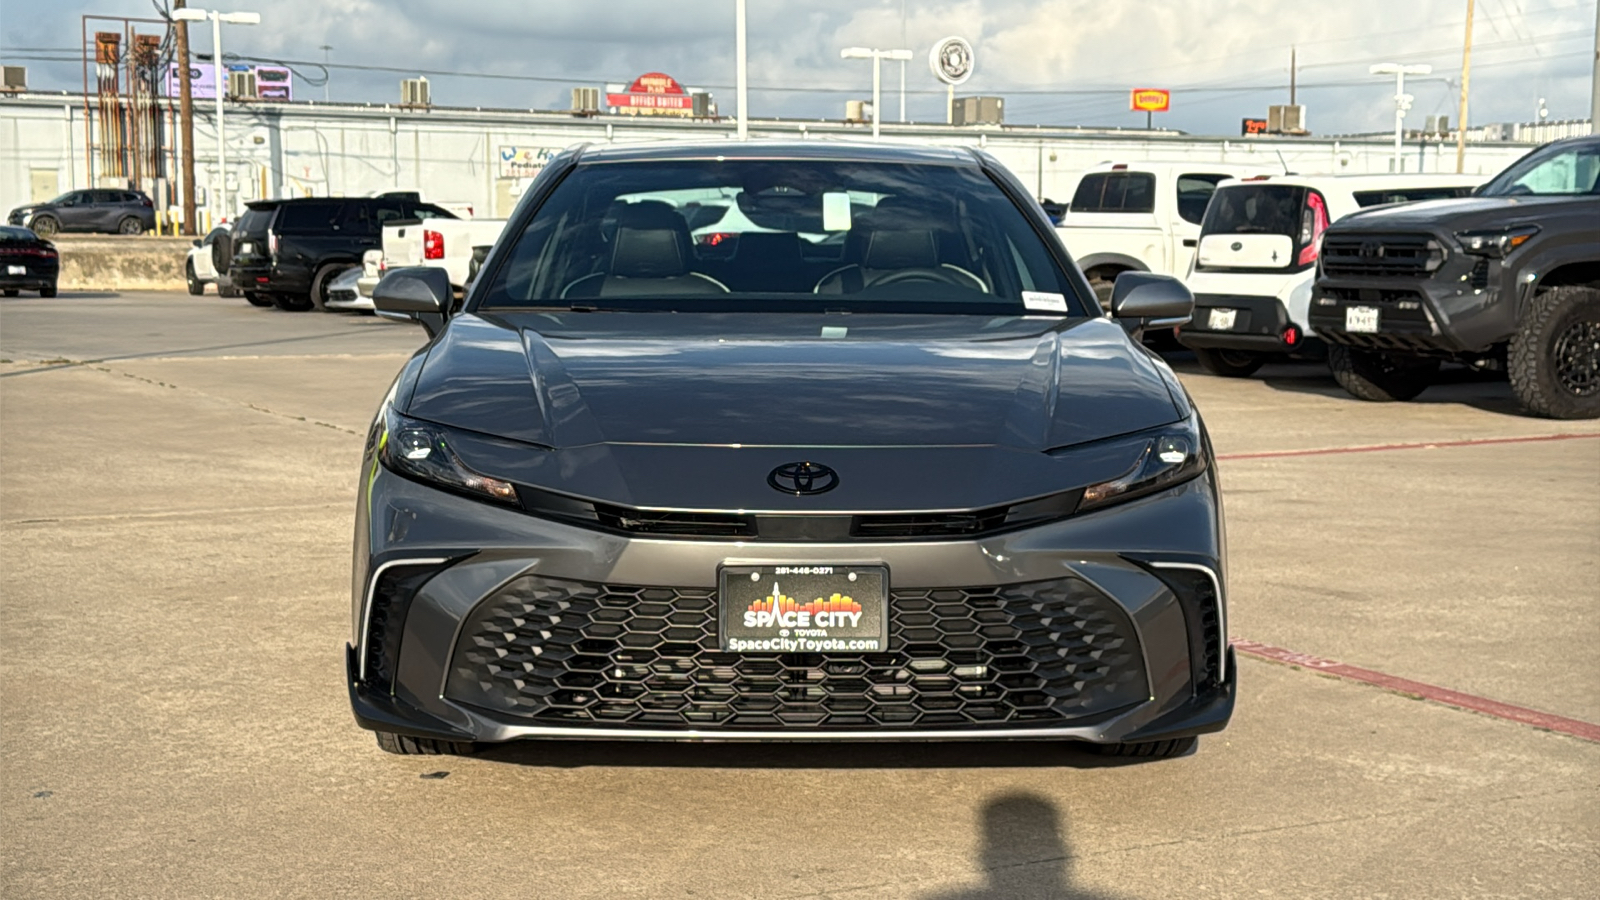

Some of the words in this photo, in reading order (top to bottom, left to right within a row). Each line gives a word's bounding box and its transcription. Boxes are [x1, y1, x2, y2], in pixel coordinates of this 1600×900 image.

[630, 95, 656, 107] OFFICE
[775, 567, 834, 575] 281-446-0271
[815, 611, 863, 628] CITY
[794, 629, 828, 638] TOYOTA
[729, 638, 879, 652] SpaceCityToyota.com
